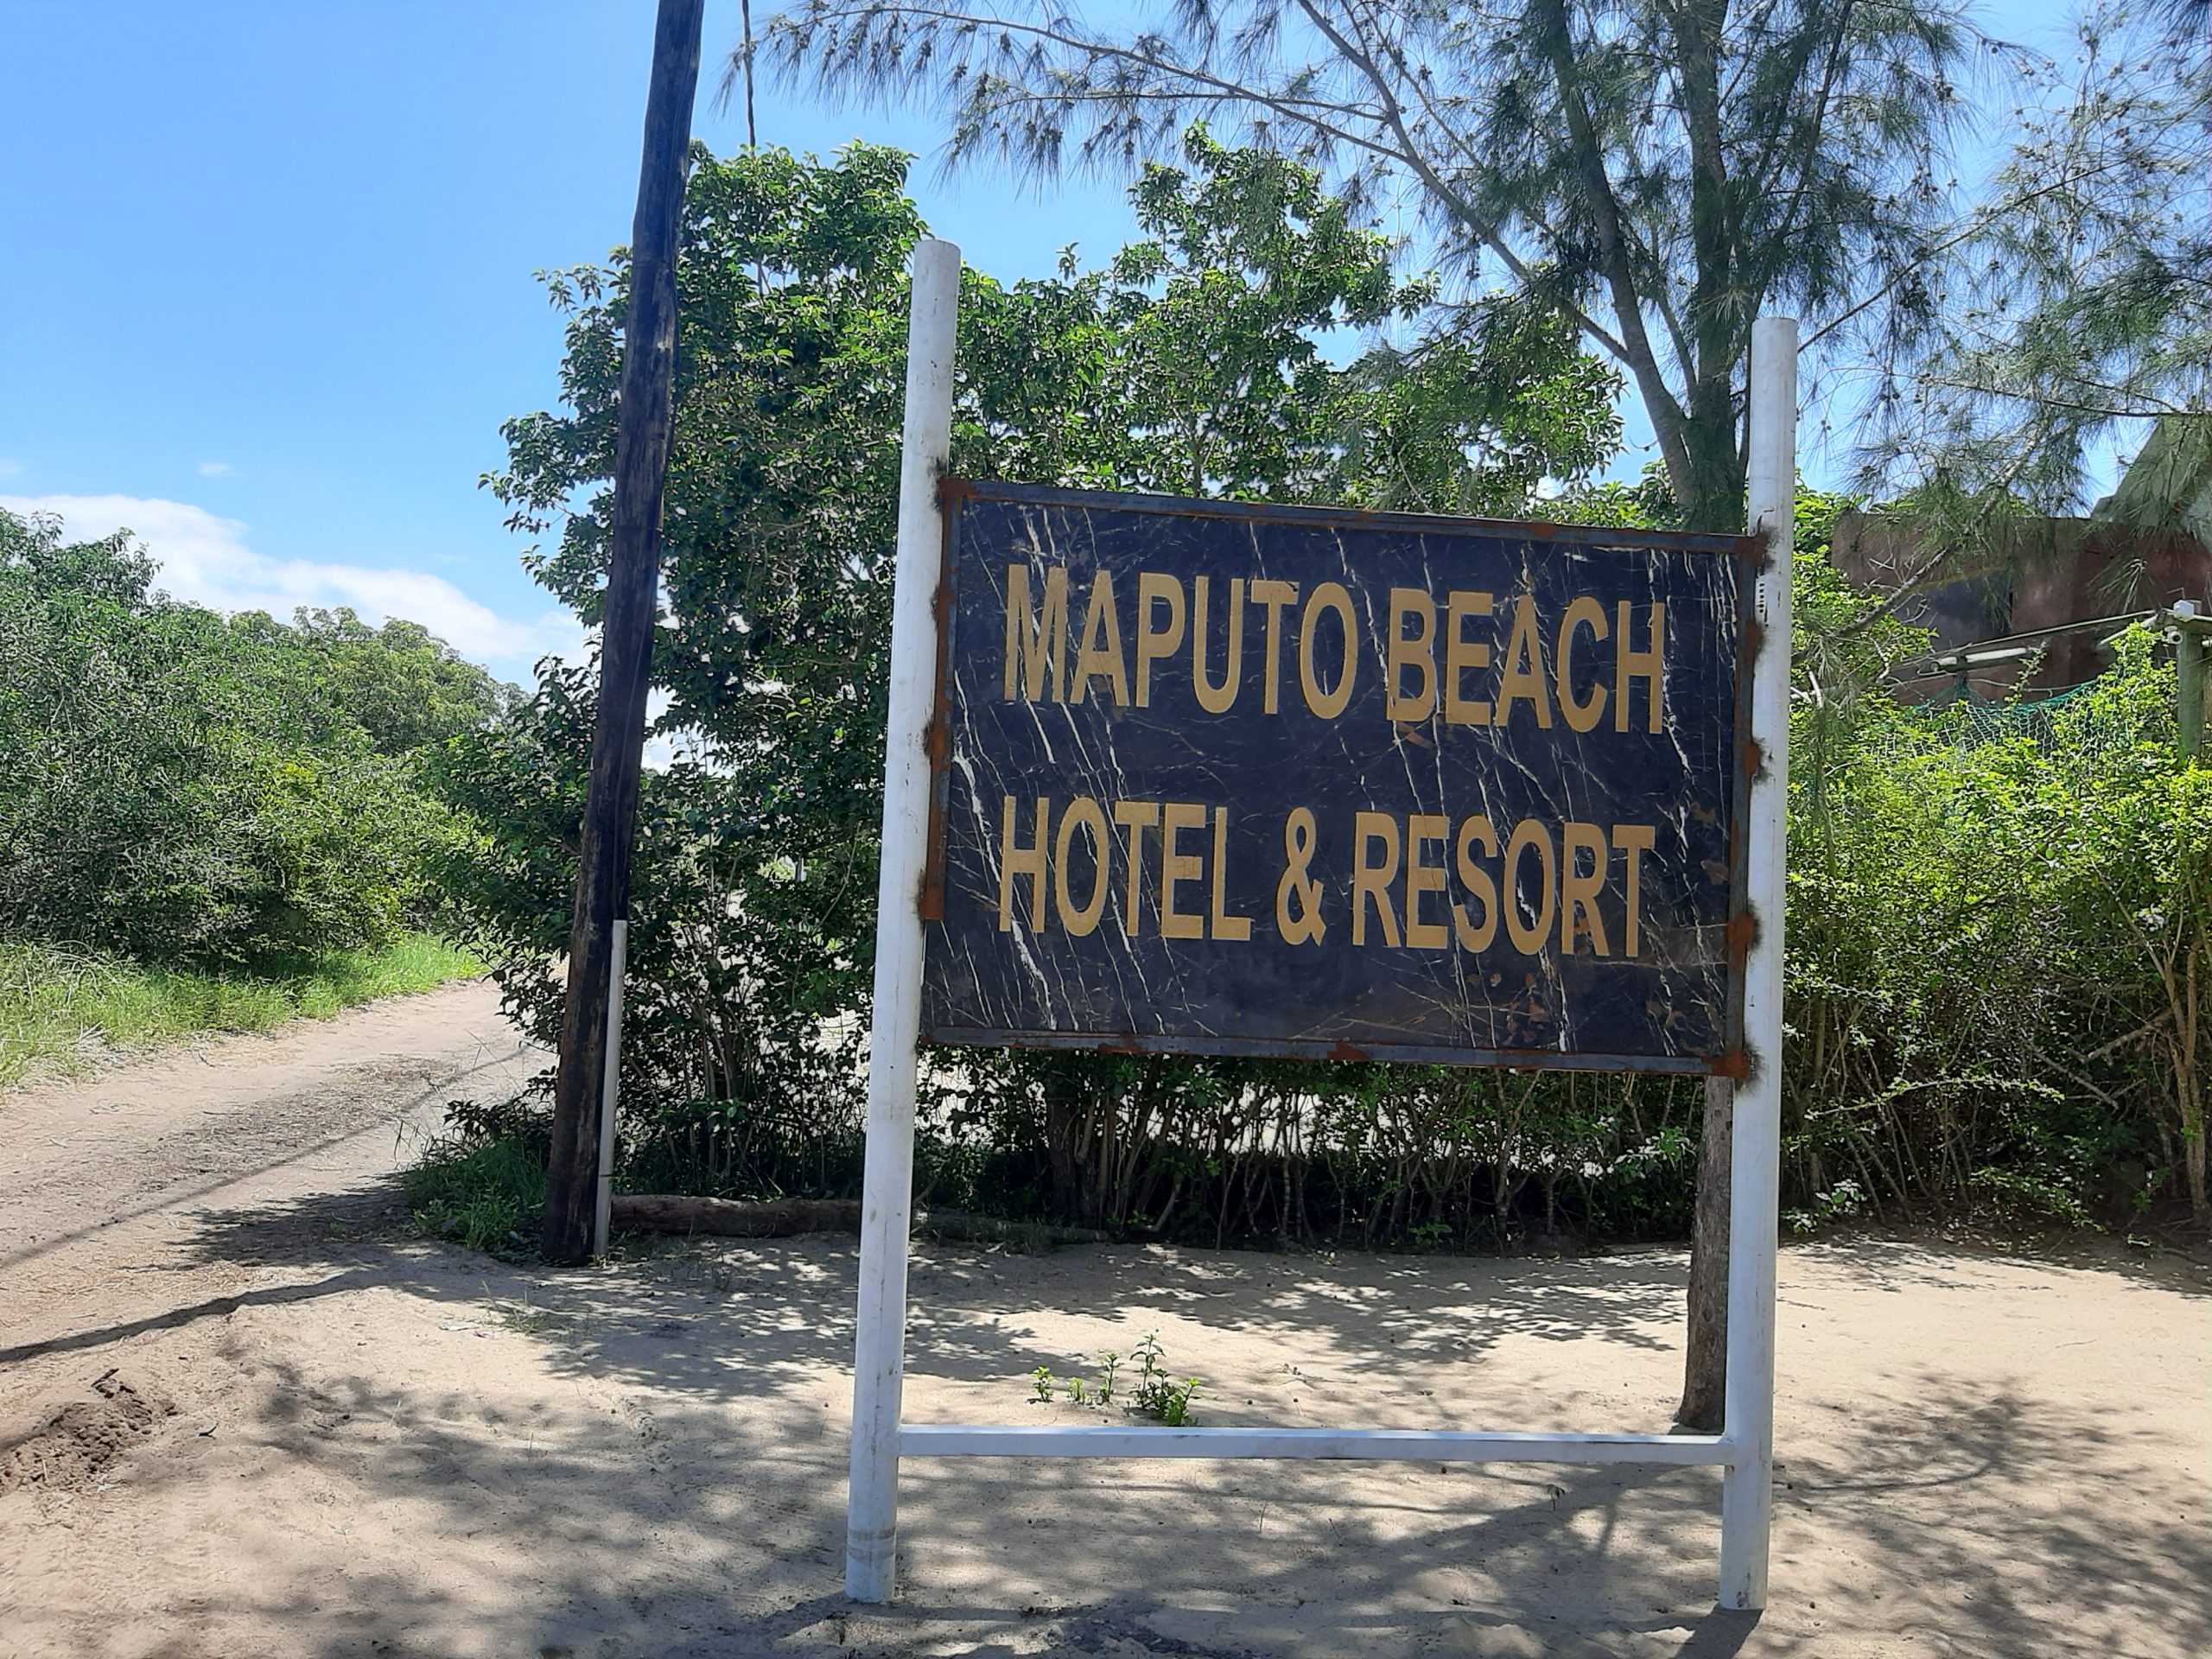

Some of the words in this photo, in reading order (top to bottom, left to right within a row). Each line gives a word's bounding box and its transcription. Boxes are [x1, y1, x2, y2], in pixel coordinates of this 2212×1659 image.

[1004, 563, 1358, 719] MAPUTO
[1386, 588, 1665, 734] BEACH
[999, 795, 1251, 941] HOTEL
[1276, 805, 1325, 944] &
[1352, 810, 1655, 957] RESORT
